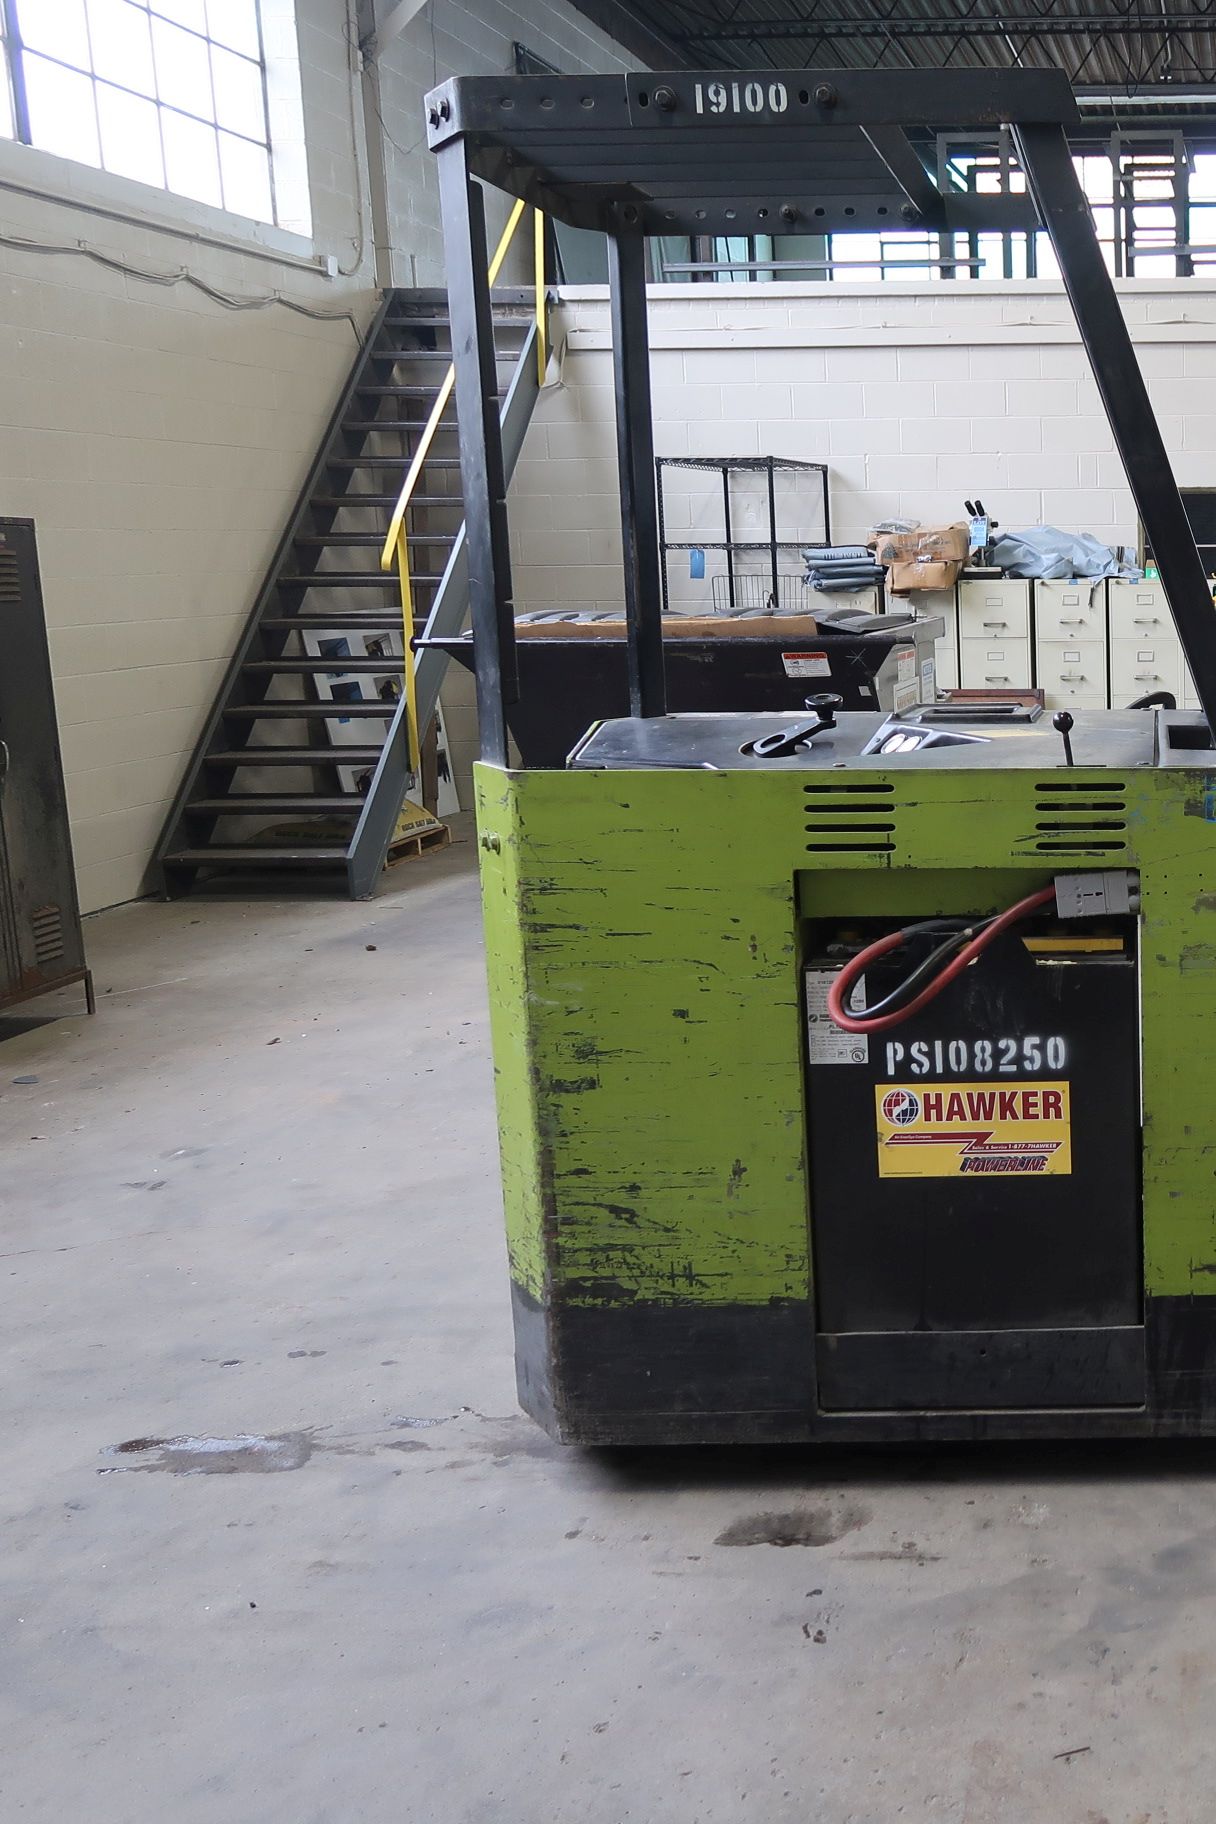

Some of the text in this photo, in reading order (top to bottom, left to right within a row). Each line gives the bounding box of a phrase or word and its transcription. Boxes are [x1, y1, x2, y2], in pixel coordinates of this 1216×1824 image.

[695, 82, 788, 114] 19100
[922, 1090, 1063, 1122] HAWKER
[960, 1156, 1049, 1172] POWERLINE
